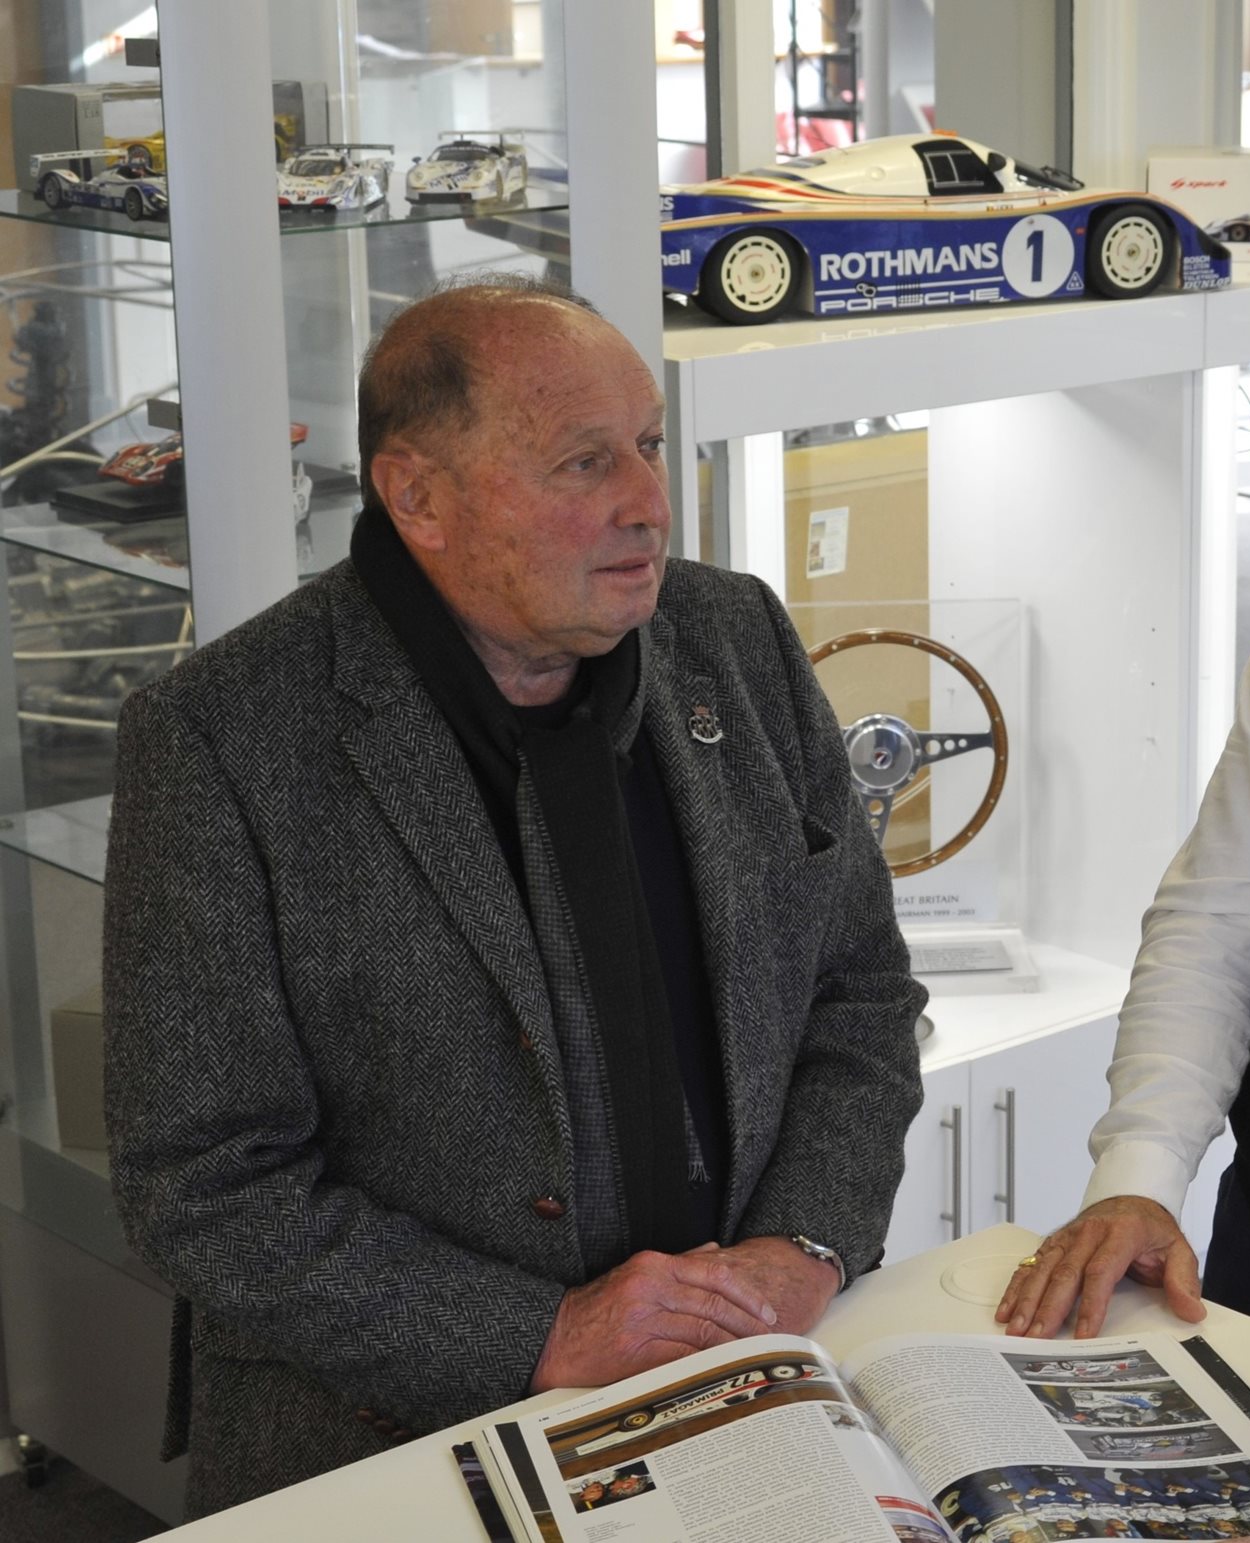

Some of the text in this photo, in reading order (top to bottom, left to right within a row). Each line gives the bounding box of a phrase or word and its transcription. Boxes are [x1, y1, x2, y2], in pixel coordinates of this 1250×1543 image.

[662, 248, 691, 266] ell
[820, 242, 1000, 281] ROTHMANS
[1026, 230, 1044, 282] 1
[1183, 256, 1210, 264] BOSCH
[1183, 277, 1232, 290] DUNLOP
[820, 287, 1000, 313] PORSCHE
[894, 895, 960, 906] EAT BRITAIN
[896, 909, 931, 917] HAIRMAN
[728, 1374, 756, 1389] 72
[660, 1387, 725, 1419] PRIMAGAZ
